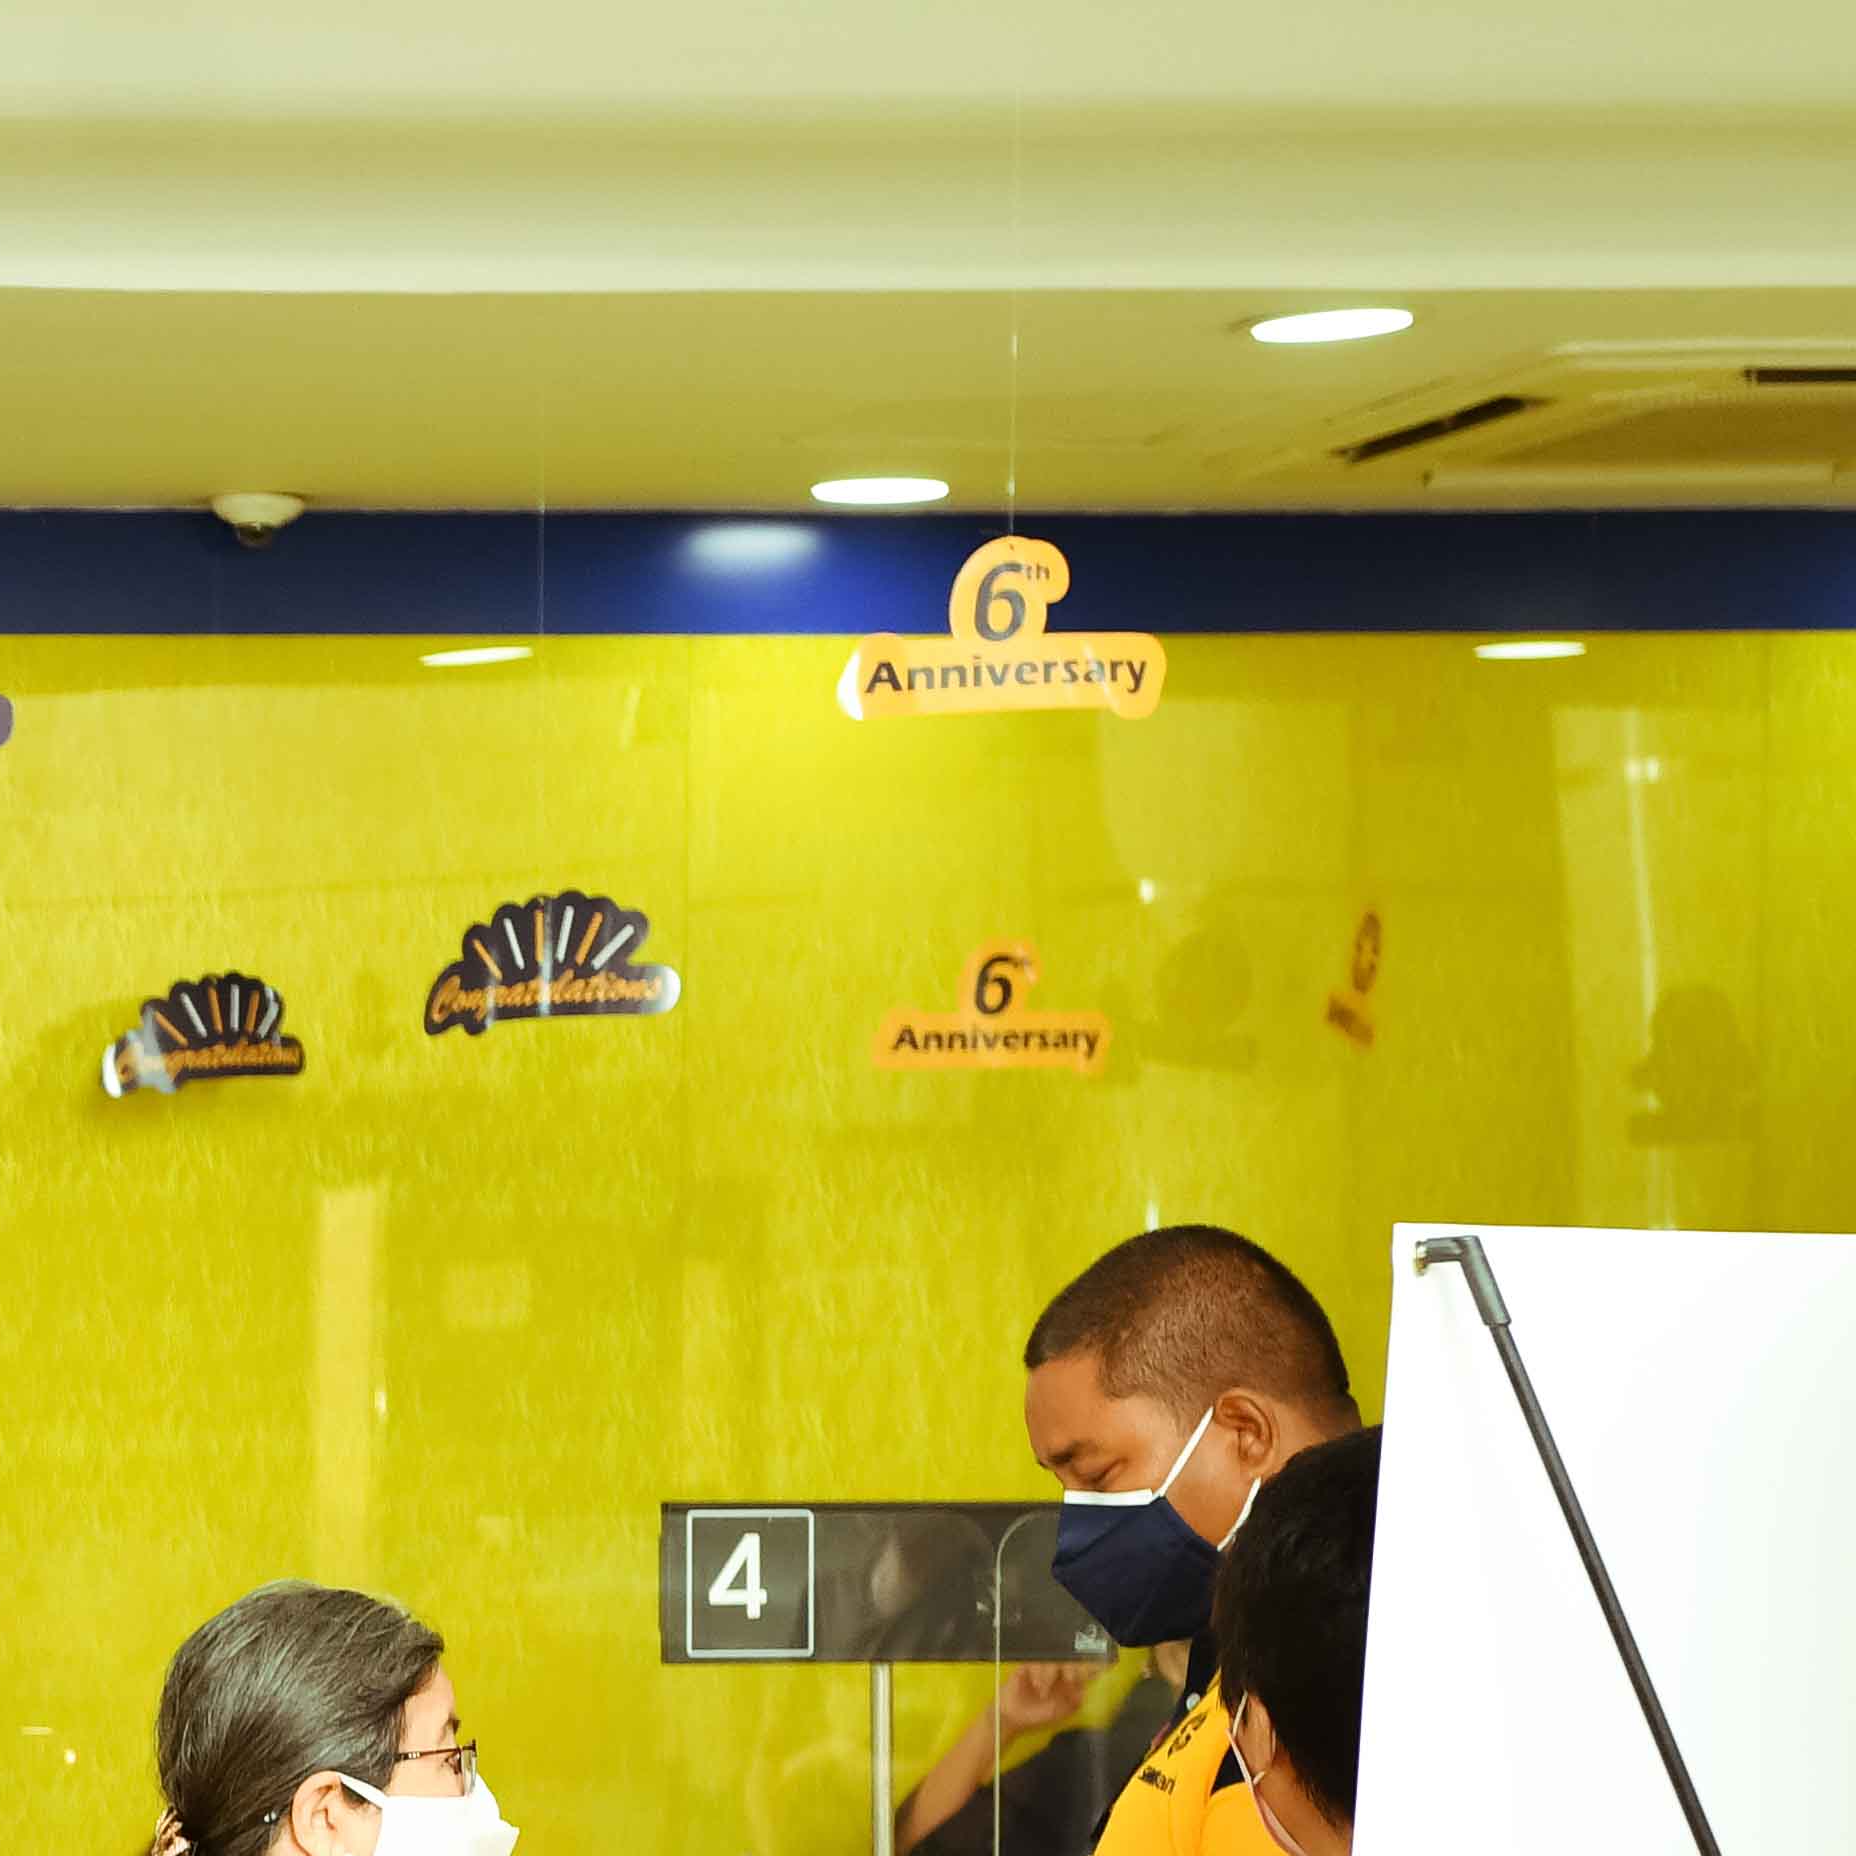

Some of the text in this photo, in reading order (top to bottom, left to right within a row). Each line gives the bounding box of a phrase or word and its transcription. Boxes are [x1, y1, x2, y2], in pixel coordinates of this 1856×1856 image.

[974, 561, 1051, 642] 6th
[865, 656, 1147, 694] Anniversary
[893, 1024, 1100, 1060] Anniversary
[708, 1531, 768, 1620] 4
